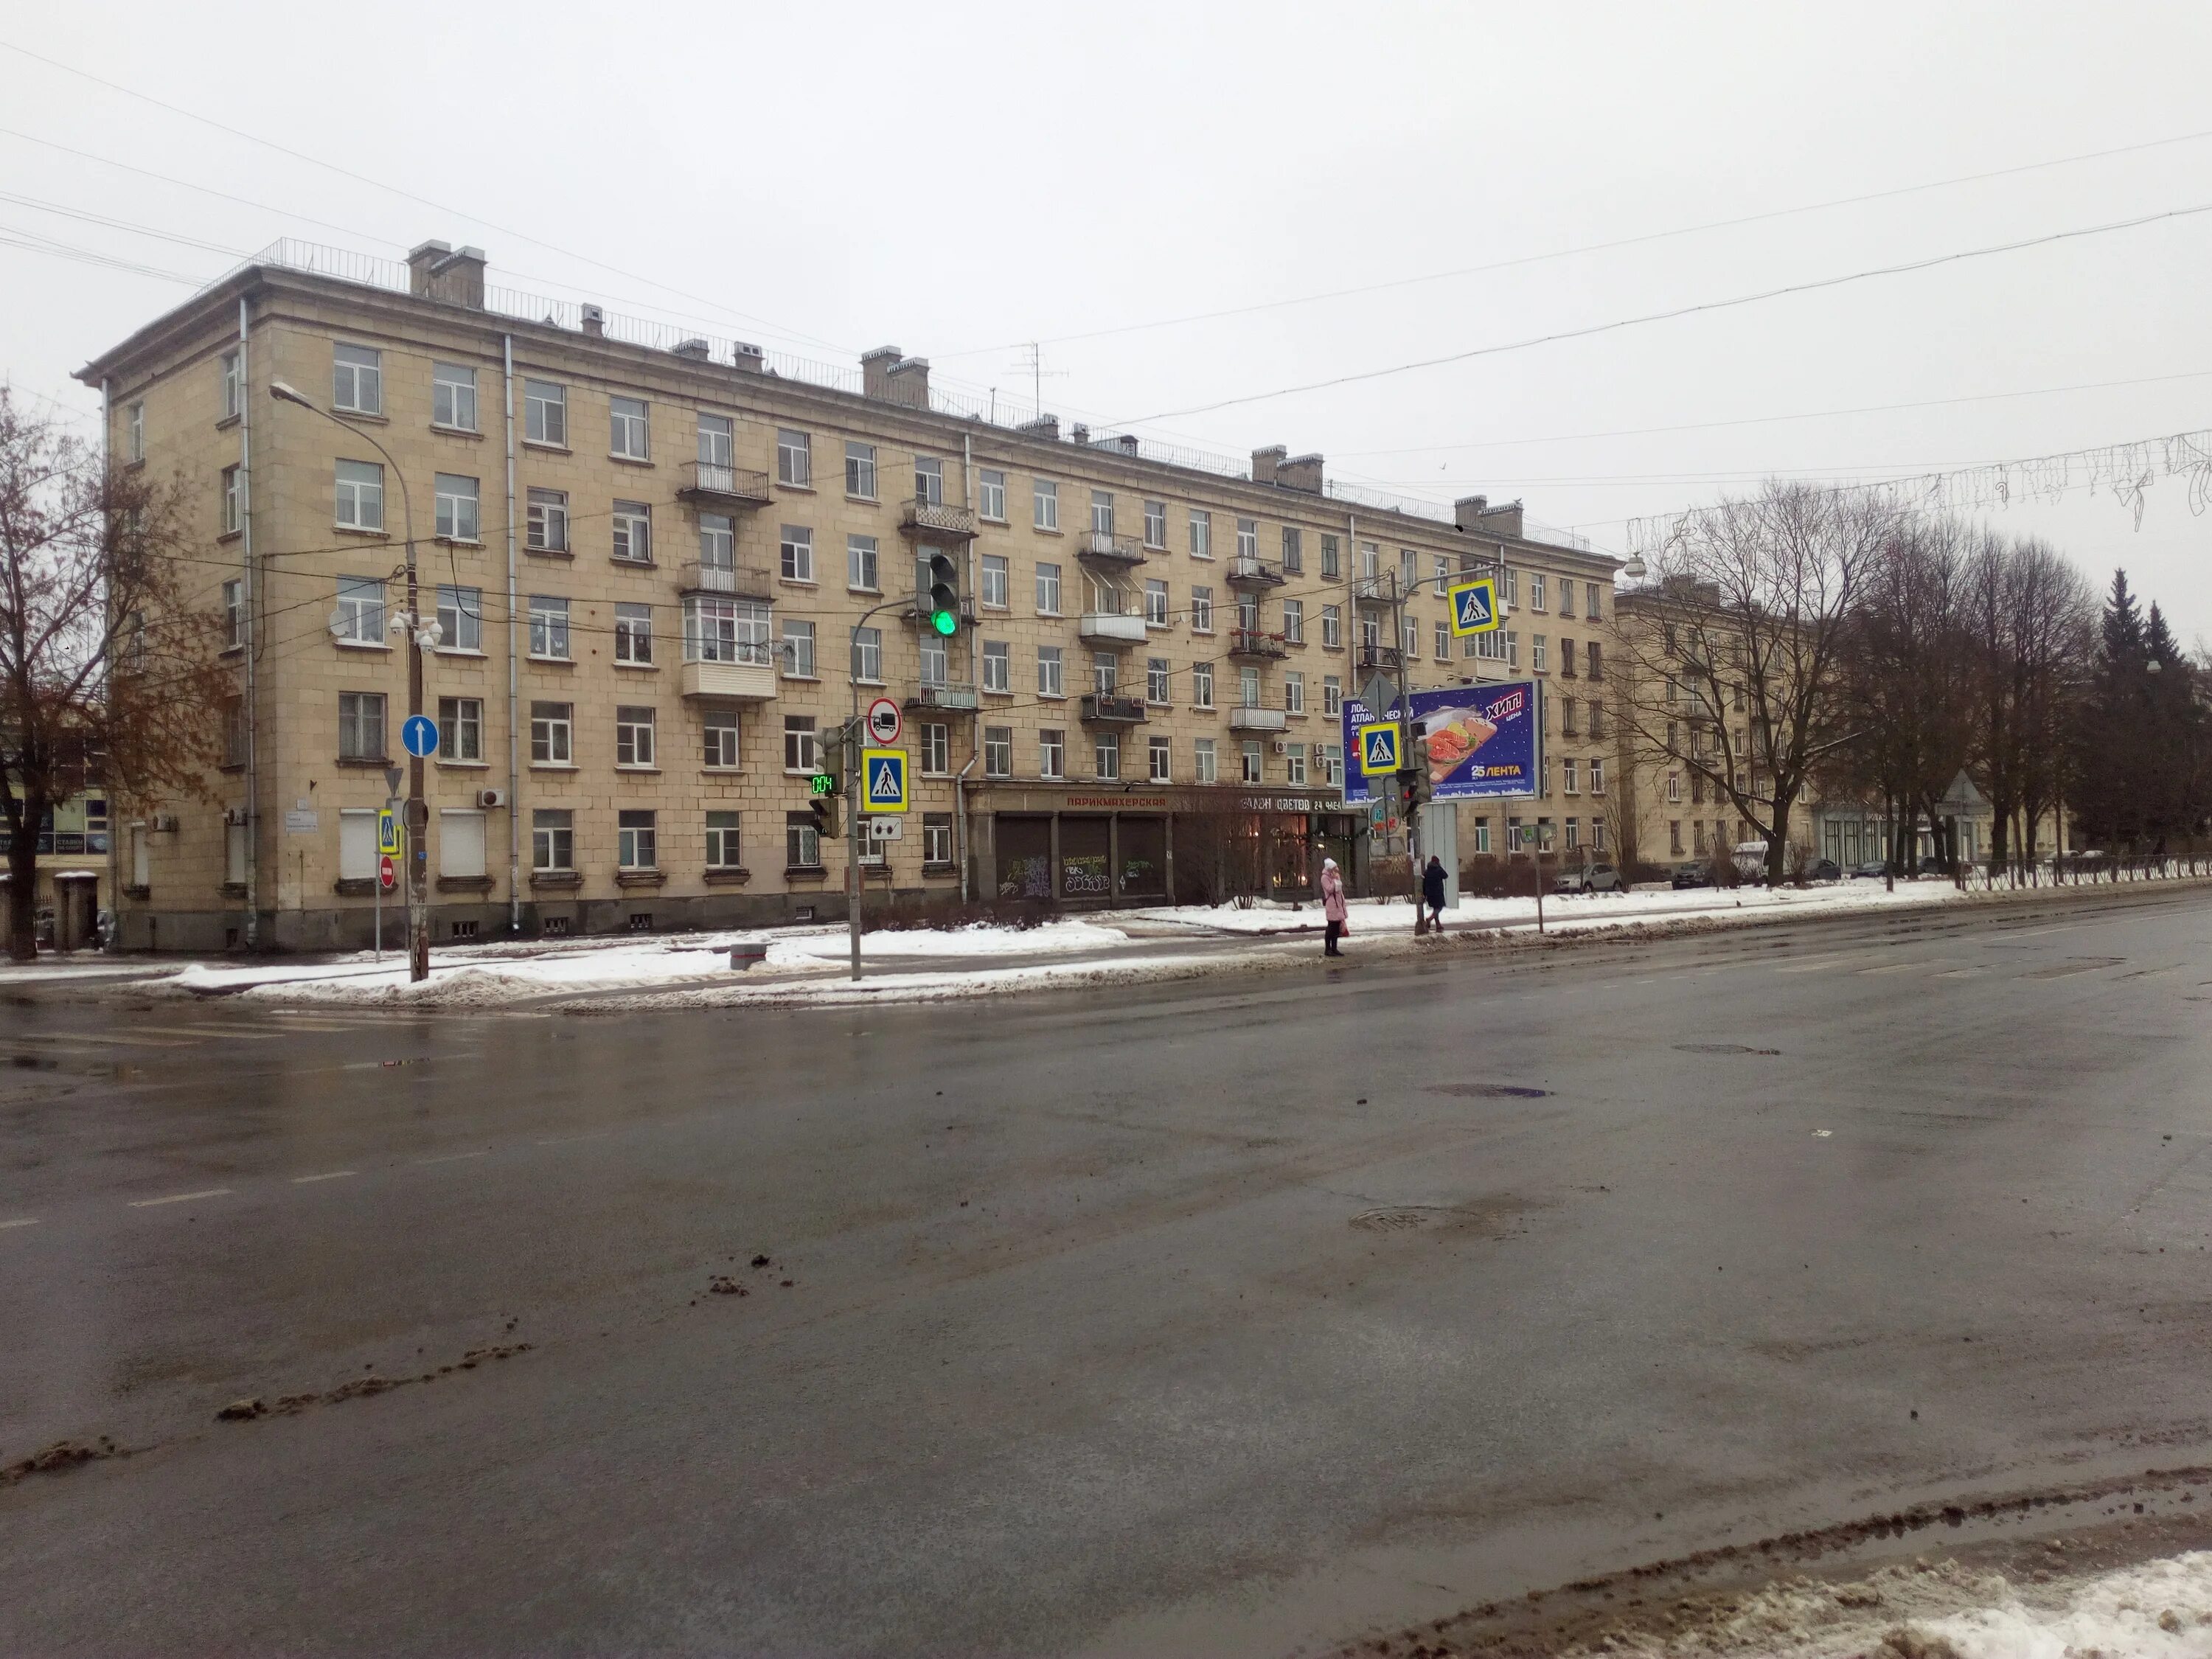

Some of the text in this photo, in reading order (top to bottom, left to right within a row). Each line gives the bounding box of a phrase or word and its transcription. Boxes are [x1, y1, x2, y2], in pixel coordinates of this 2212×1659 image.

[1486, 692, 1522, 721] ХИТ!
[1506, 711, 1522, 722] ЦЕНА
[1471, 765, 1521, 777] 25 ЛЕНТА
[813, 776, 832, 793] 004
[1068, 797, 1166, 807] ПАРИКМАХЕРСКАЯ
[1276, 799, 1310, 811] ЦВЕТОВ
[1314, 801, 1323, 810] 24
